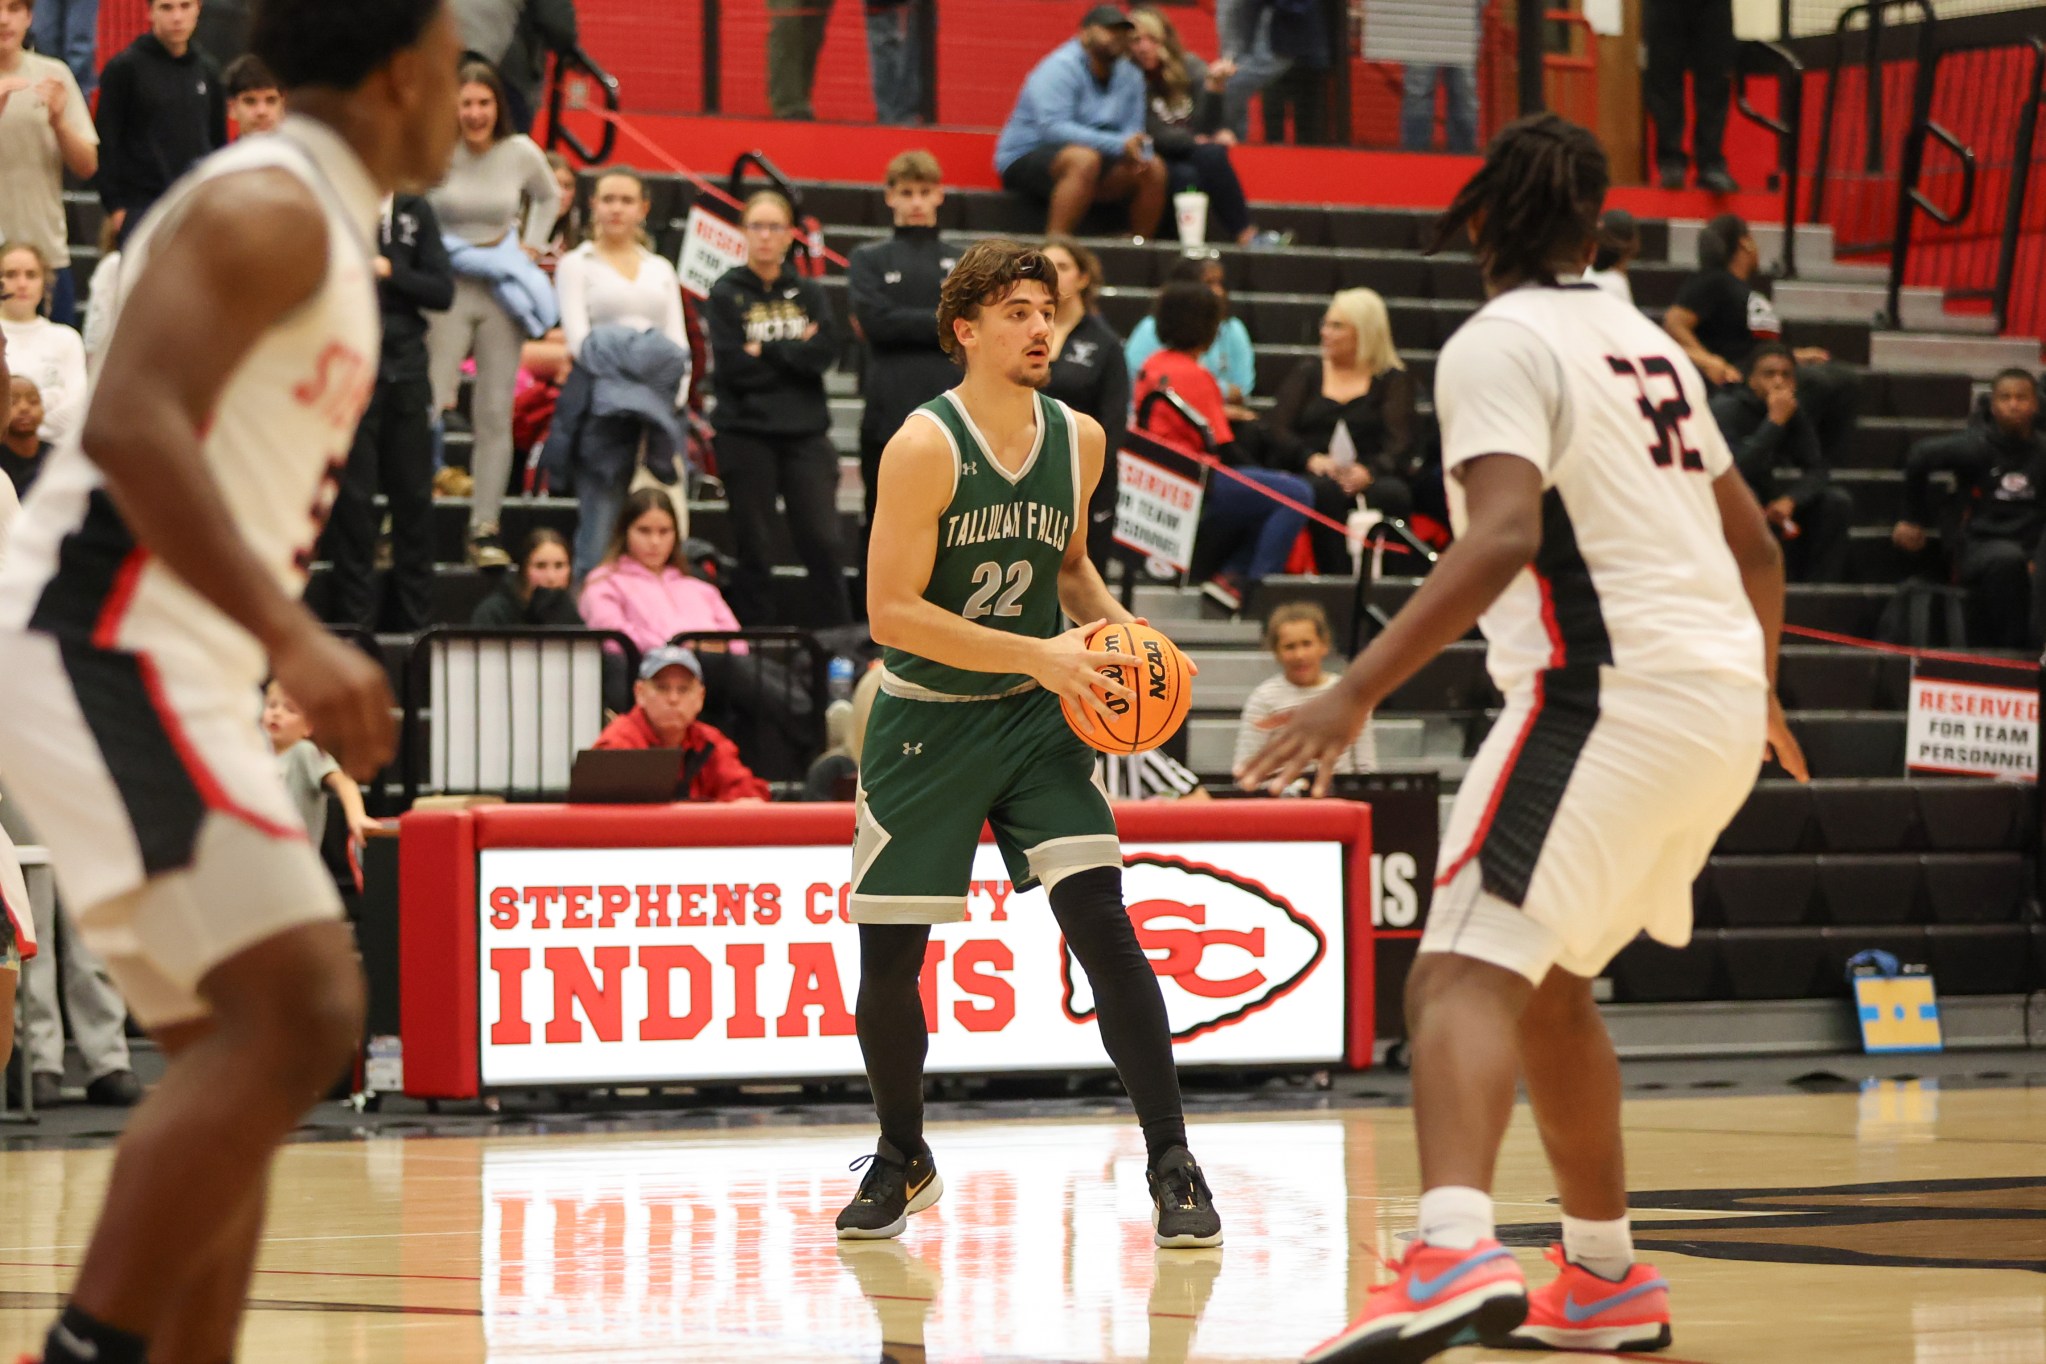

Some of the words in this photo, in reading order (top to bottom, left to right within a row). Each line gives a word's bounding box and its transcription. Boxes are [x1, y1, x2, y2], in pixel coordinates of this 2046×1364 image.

[1027, 501, 1069, 552] FALLS
[962, 559, 1034, 619] 22
[1143, 641, 1167, 701] NCAA
[1929, 720, 1966, 738] FOR
[1974, 725, 2029, 744] TEAM
[1919, 745, 2033, 770] PERSONNEL
[489, 882, 782, 930] STEPHENS
